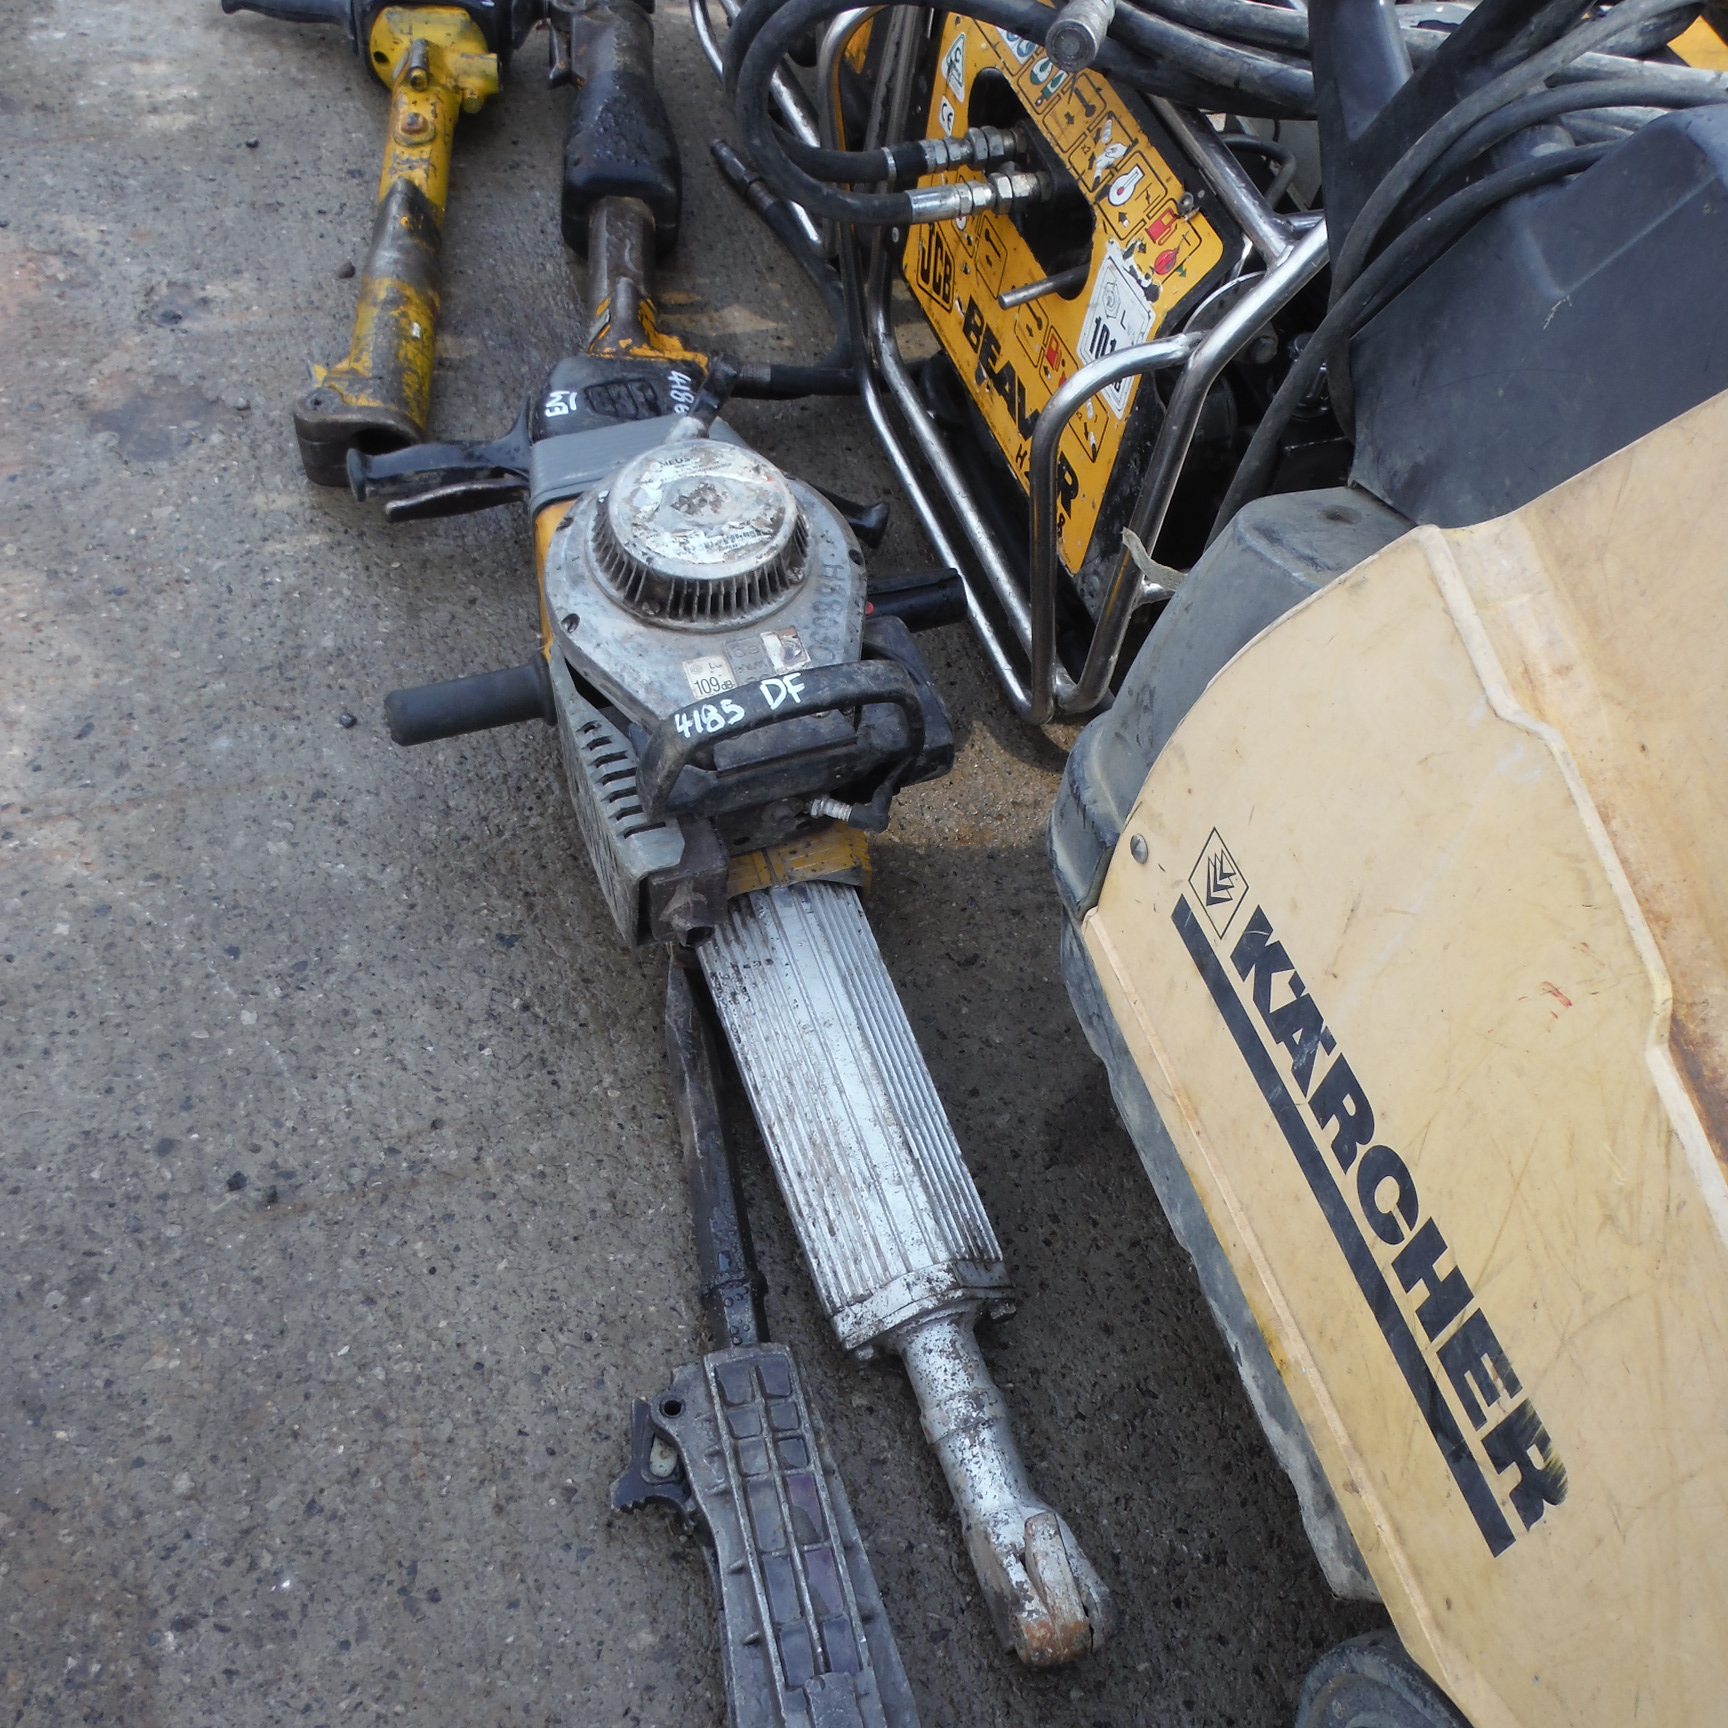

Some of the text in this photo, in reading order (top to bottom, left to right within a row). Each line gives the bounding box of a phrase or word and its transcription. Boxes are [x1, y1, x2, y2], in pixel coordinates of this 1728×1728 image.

[920, 223, 953, 304] JCB
[962, 294, 1079, 519] BEAVR
[674, 672, 806, 739] 4185 DF
